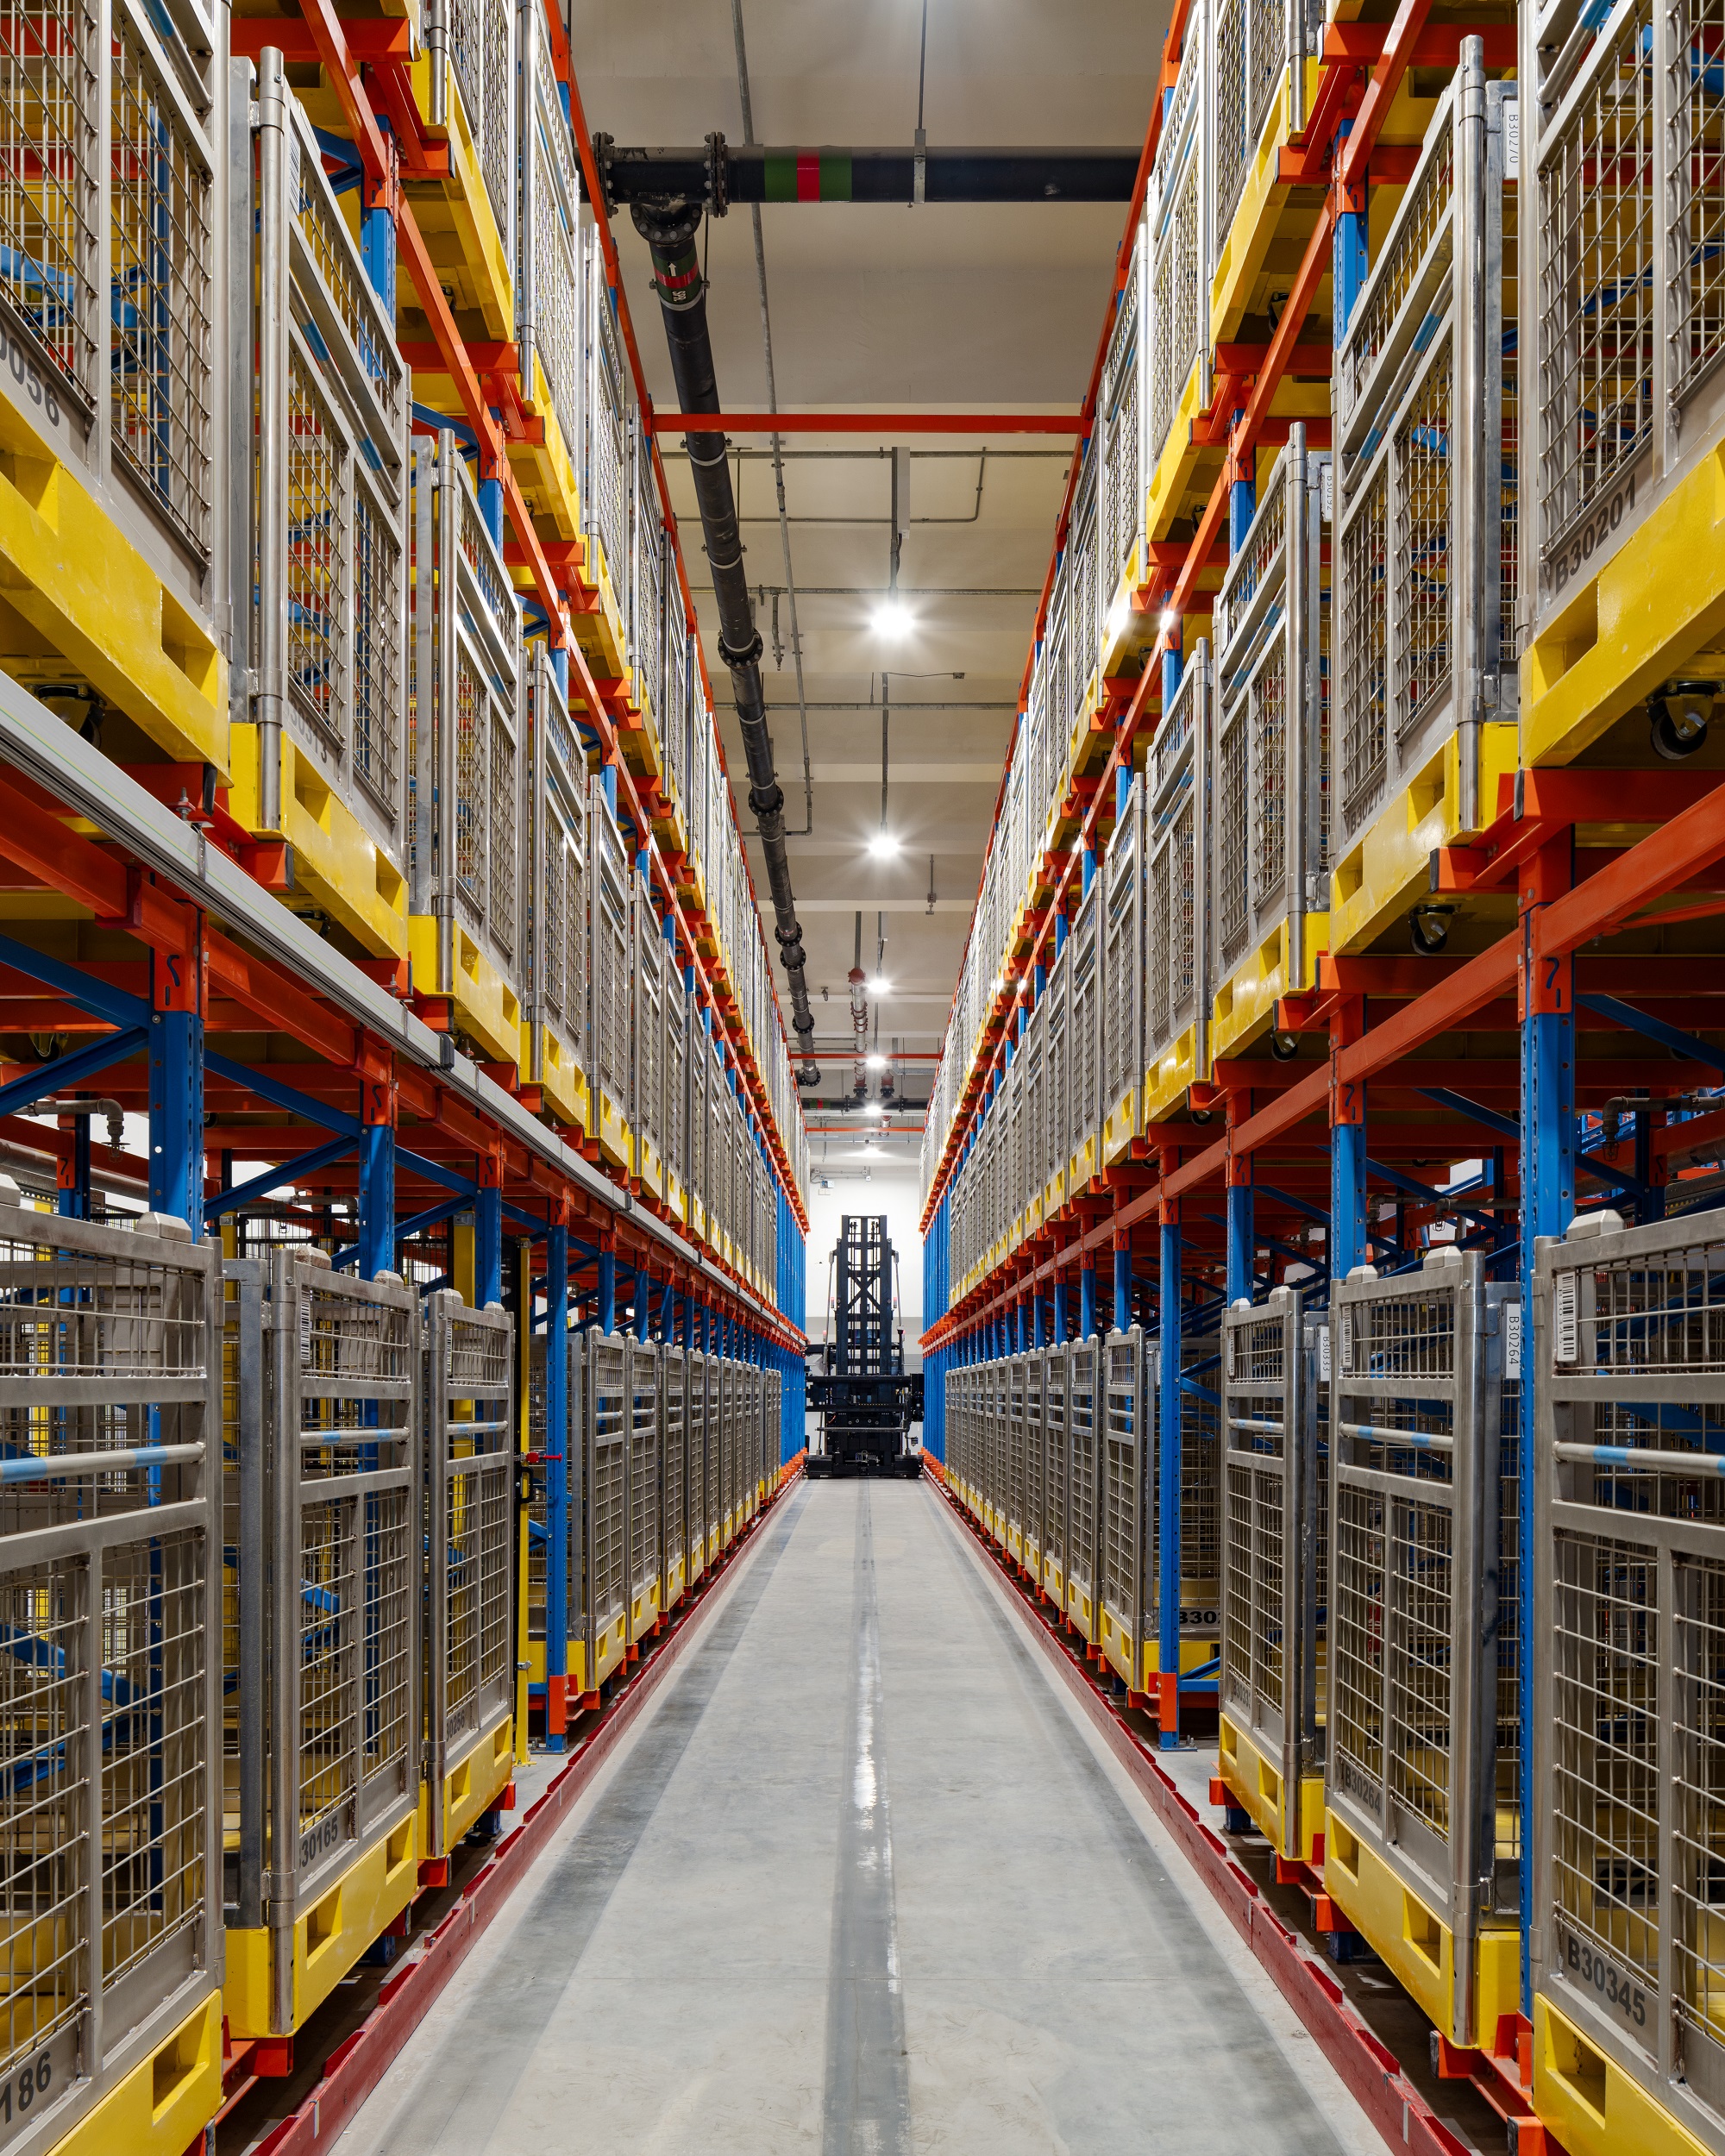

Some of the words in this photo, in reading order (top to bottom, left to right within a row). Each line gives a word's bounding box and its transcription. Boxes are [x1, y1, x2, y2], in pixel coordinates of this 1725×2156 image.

[1556, 473, 1635, 595] B30201
[287, 697, 328, 764] 30313
[1351, 777, 1385, 837] B30270
[1322, 1336, 1331, 1371] B30333
[1509, 1316, 1520, 1365] B30264
[1179, 1610, 1220, 1624] B30
[1346, 1764, 1381, 1817] B30264
[298, 1814, 338, 1870] 30165
[1568, 1934, 1646, 2027] B30345
[0, 2051, 52, 2125] 186
